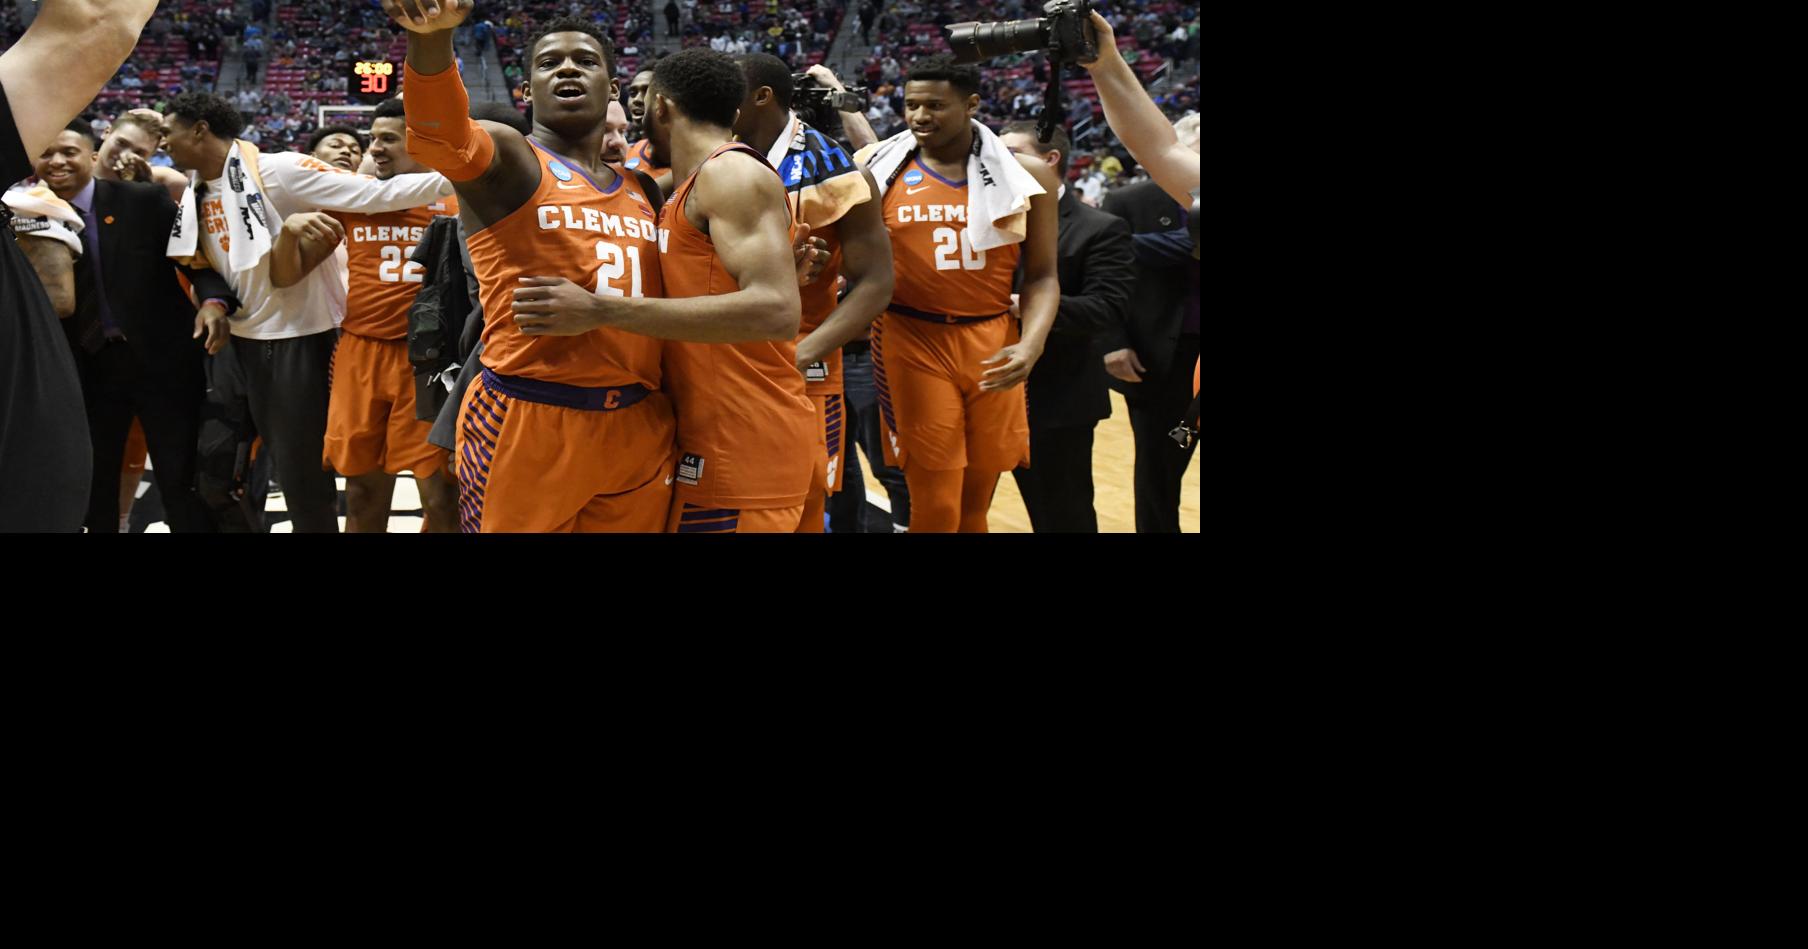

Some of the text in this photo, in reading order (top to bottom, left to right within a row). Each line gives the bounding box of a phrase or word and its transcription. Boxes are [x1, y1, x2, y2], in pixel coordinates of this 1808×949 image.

[361, 73, 387, 92] 30
[897, 204, 969, 222] CLEM
[932, 227, 986, 271] 20
[379, 245, 424, 283] 22
[594, 240, 644, 298] 21
[684, 456, 695, 465] 44
